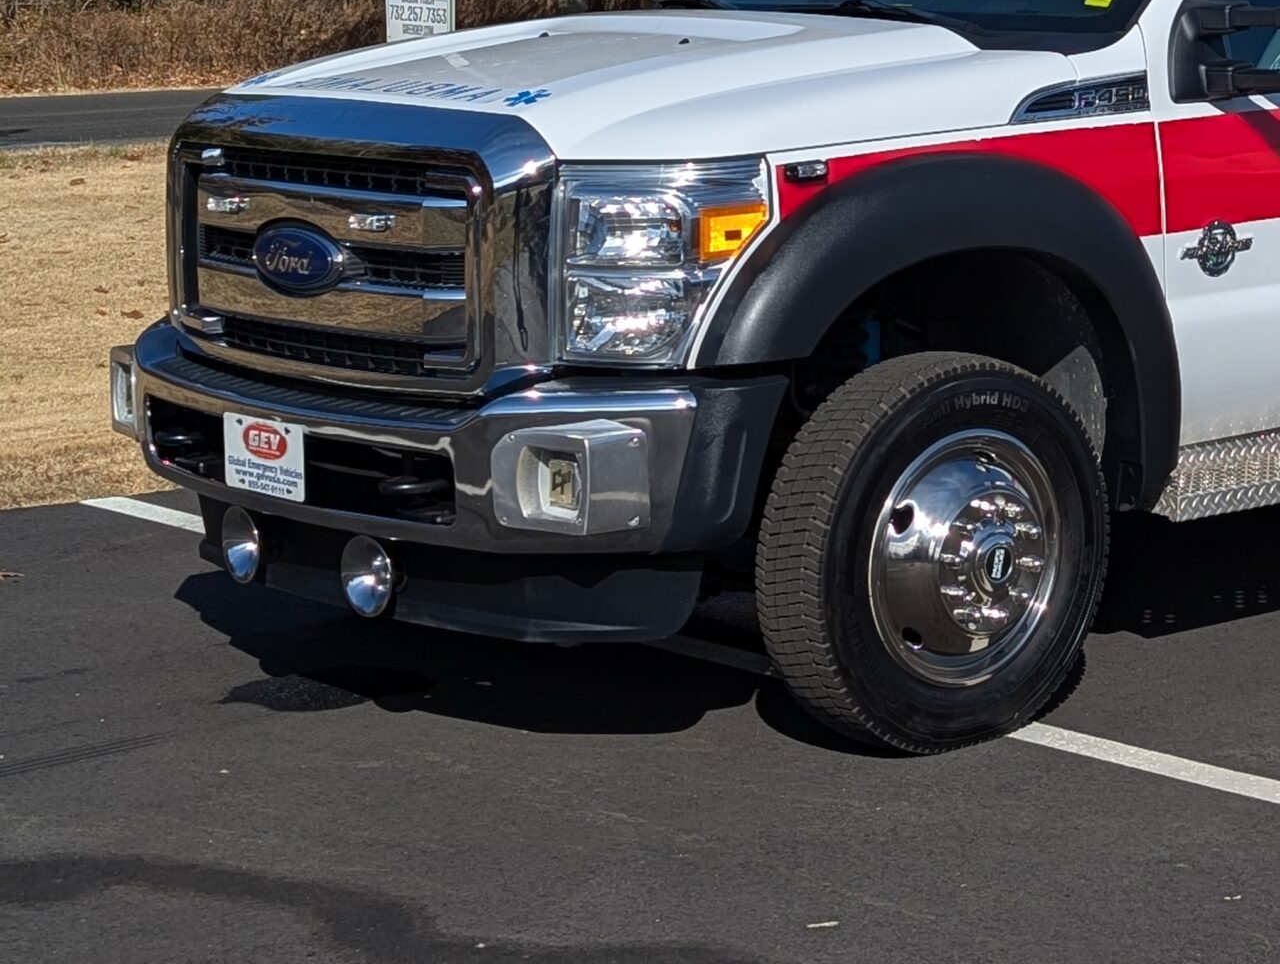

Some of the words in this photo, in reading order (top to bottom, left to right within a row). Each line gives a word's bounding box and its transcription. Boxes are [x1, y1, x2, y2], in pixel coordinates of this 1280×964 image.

[390, 4, 447, 25] 732.257.7353
[265, 237, 313, 275] Ford
[953, 391, 999, 410] Hybrid
[1001, 393, 1029, 413] HD3
[248, 429, 281, 451] GEV
[228, 454, 247, 468] Global
[248, 458, 278, 477] Emergency
[279, 465, 303, 480] Vehicles
